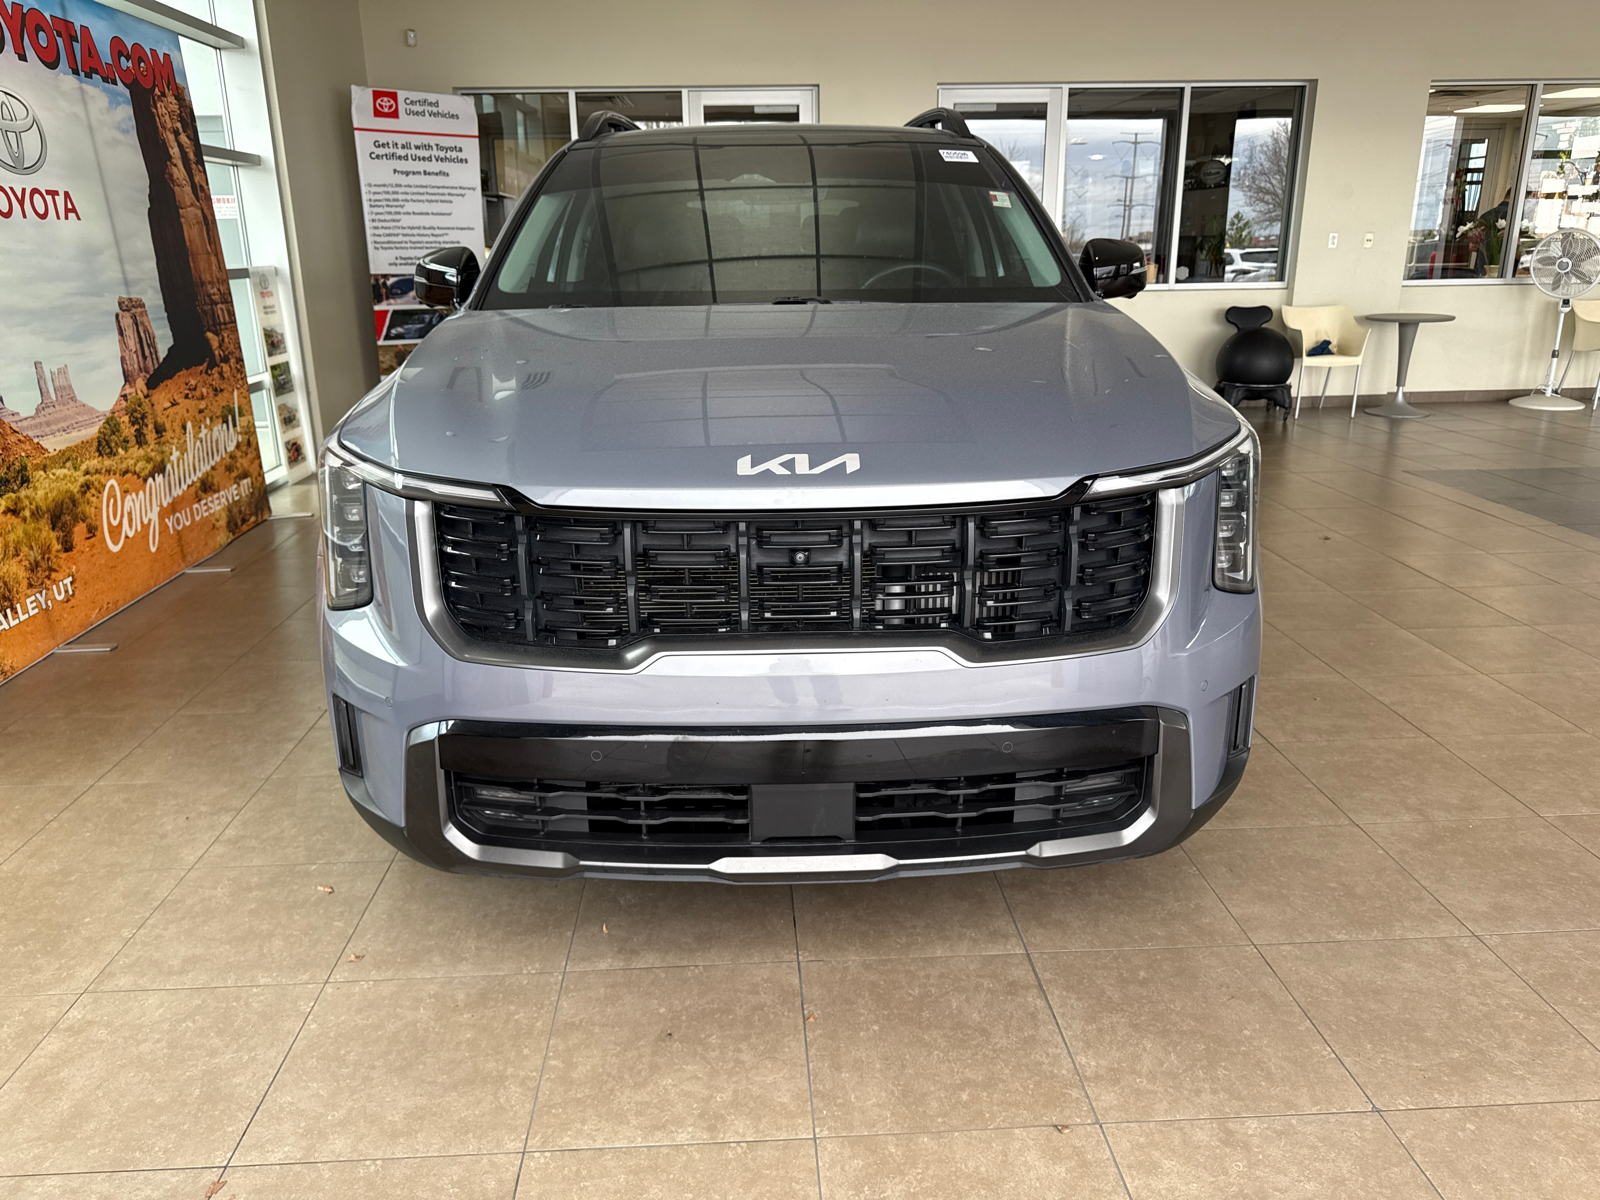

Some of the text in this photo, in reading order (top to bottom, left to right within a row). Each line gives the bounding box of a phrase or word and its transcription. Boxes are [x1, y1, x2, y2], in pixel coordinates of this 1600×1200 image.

[0, 0, 179, 97] YOTA.COM
[404, 97, 439, 108] Certified
[405, 108, 460, 120] Used Vehicles
[373, 140, 463, 154] Get it all with Toyota
[369, 151, 469, 164] Certified Used Vehicles
[393, 168, 422, 177] Program
[102, 388, 241, 553] Congratulations!
[736, 453, 861, 476] KIA
[165, 477, 253, 534] YOU DESERVE IT!
[52, 576, 74, 601] UT
